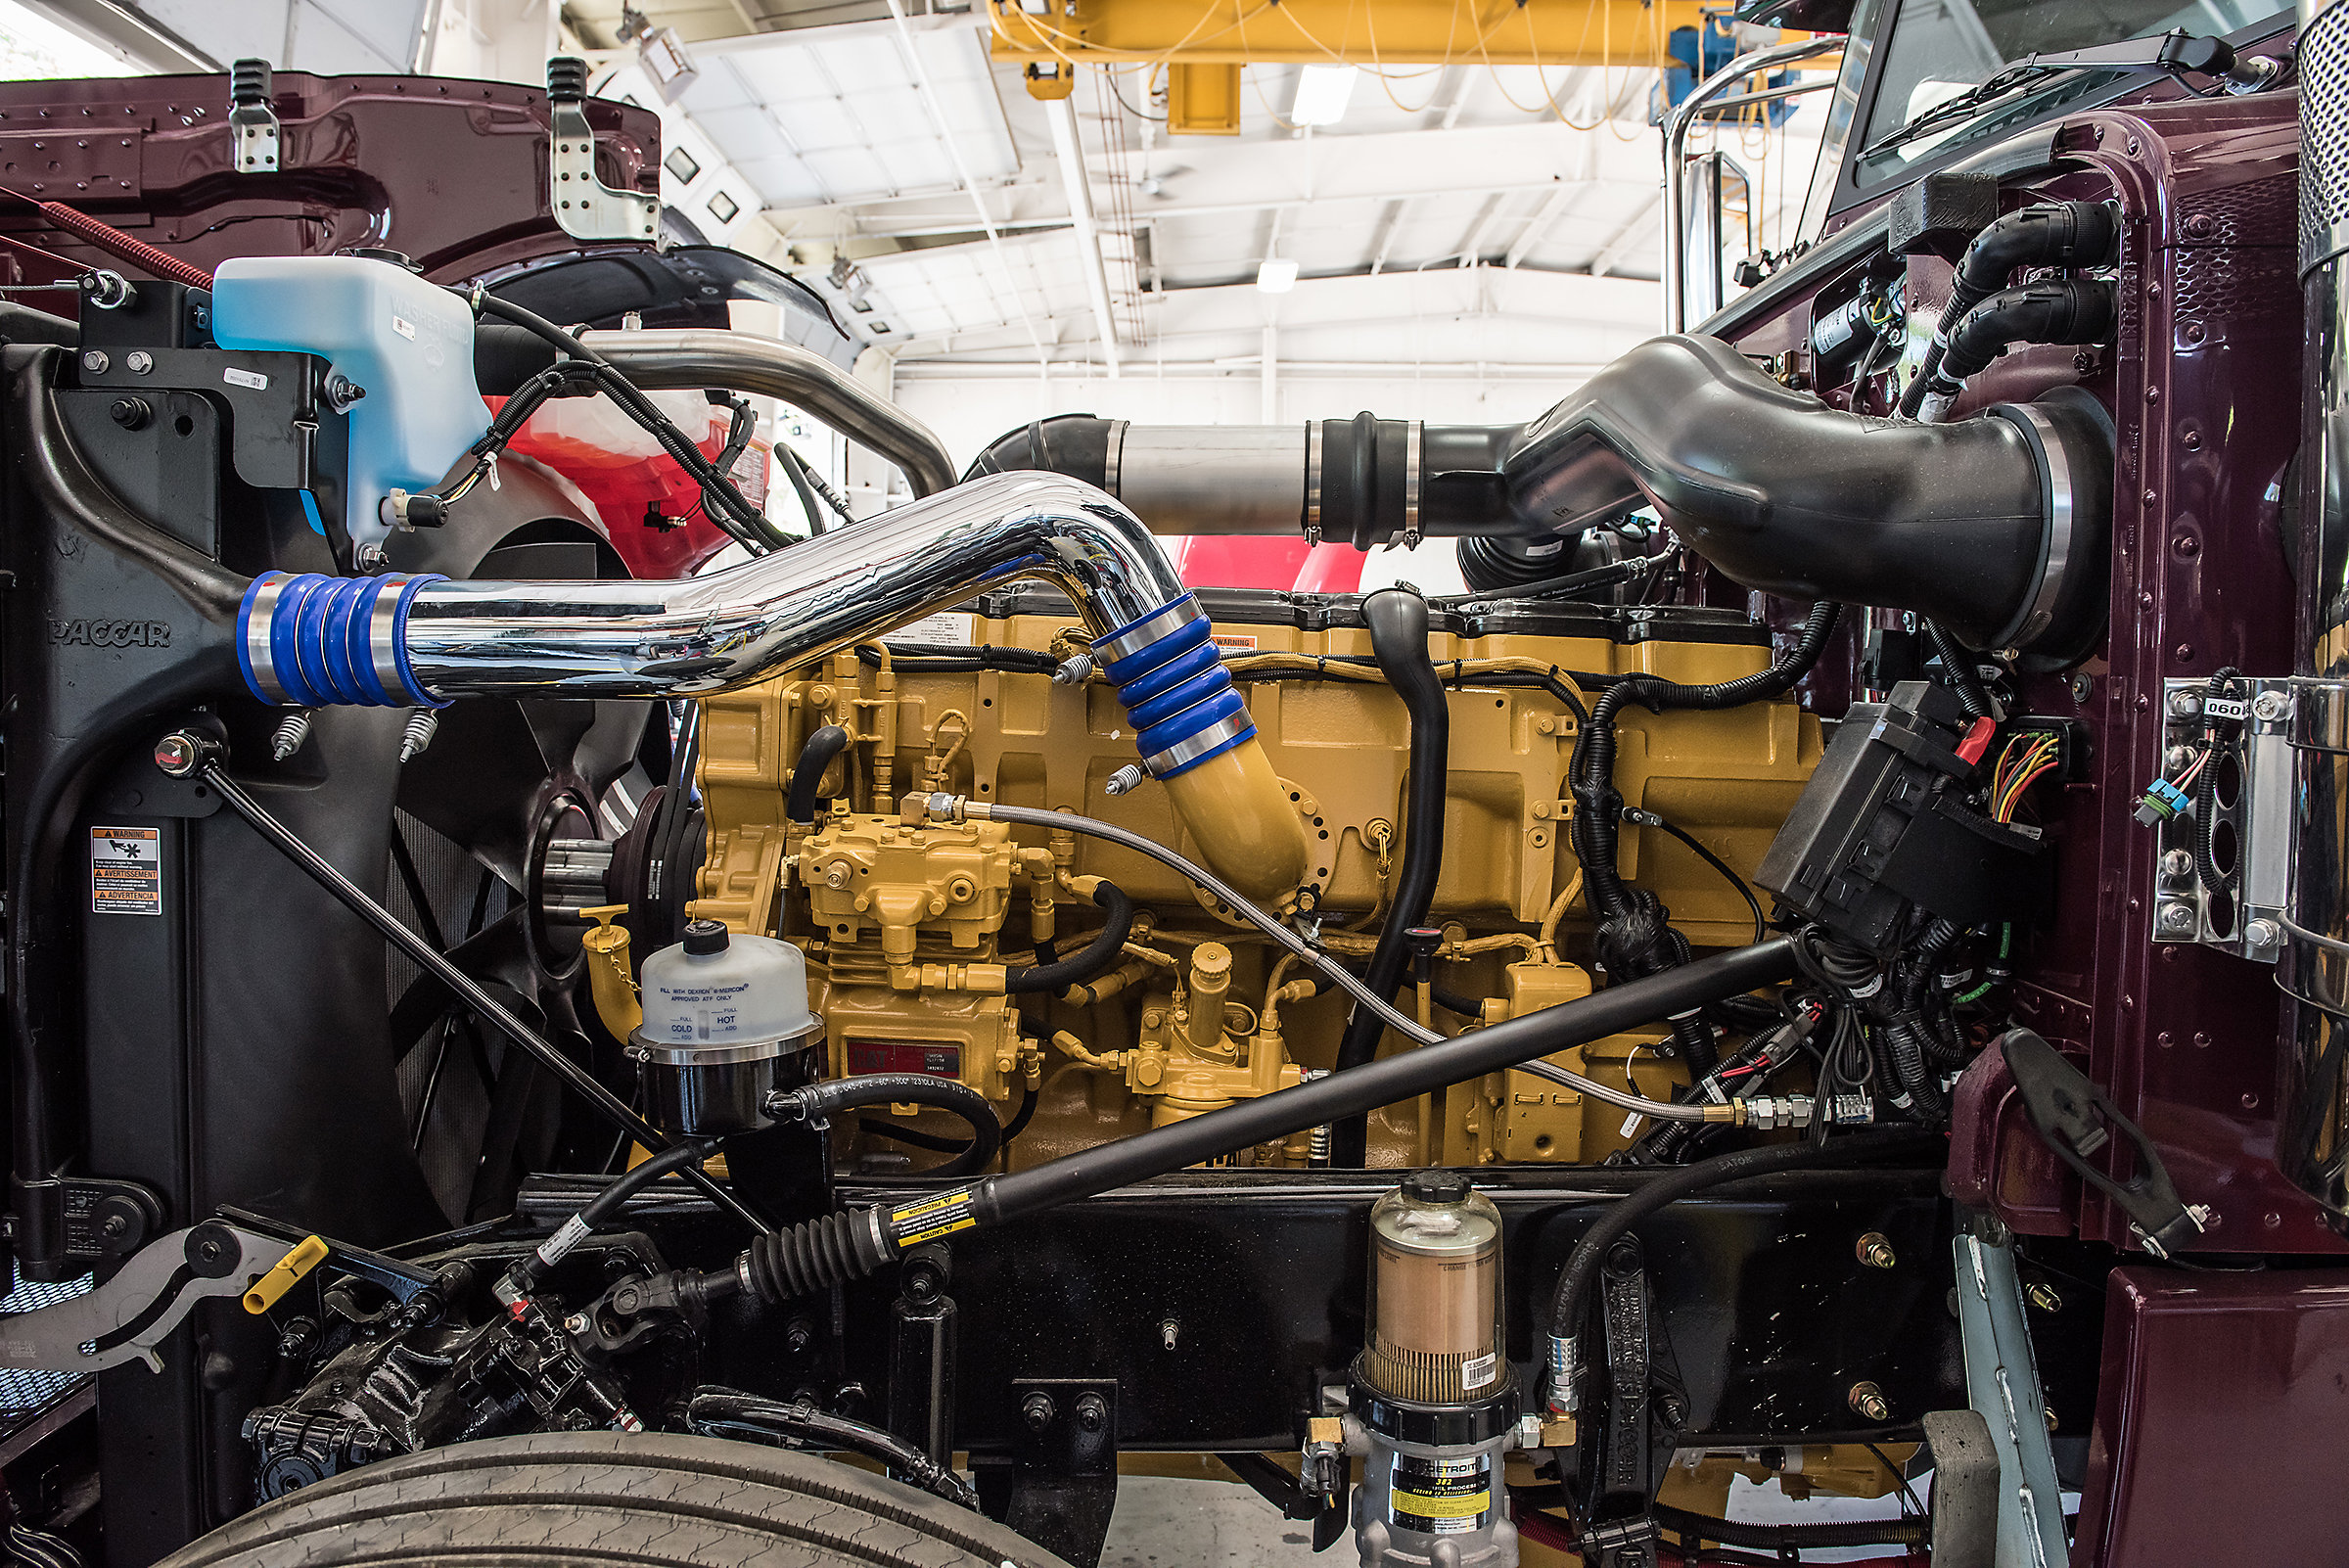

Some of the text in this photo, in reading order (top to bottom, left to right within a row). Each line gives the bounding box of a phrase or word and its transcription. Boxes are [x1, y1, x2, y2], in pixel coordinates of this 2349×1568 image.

[391, 295, 439, 331] WASHER
[47, 619, 170, 647] PACCAR
[114, 830, 146, 839] WARNING
[104, 870, 157, 879] AVERTISSEMENT
[108, 892, 155, 900] ADVERTENCIA
[716, 1015, 736, 1025] HOT
[671, 1024, 693, 1033] COLD
[853, 1048, 888, 1069] CAT
[919, 1227, 944, 1240] CAUTION
[1617, 1394, 1642, 1487] PACCAR
[1427, 1462, 1477, 1473] DETROIT
